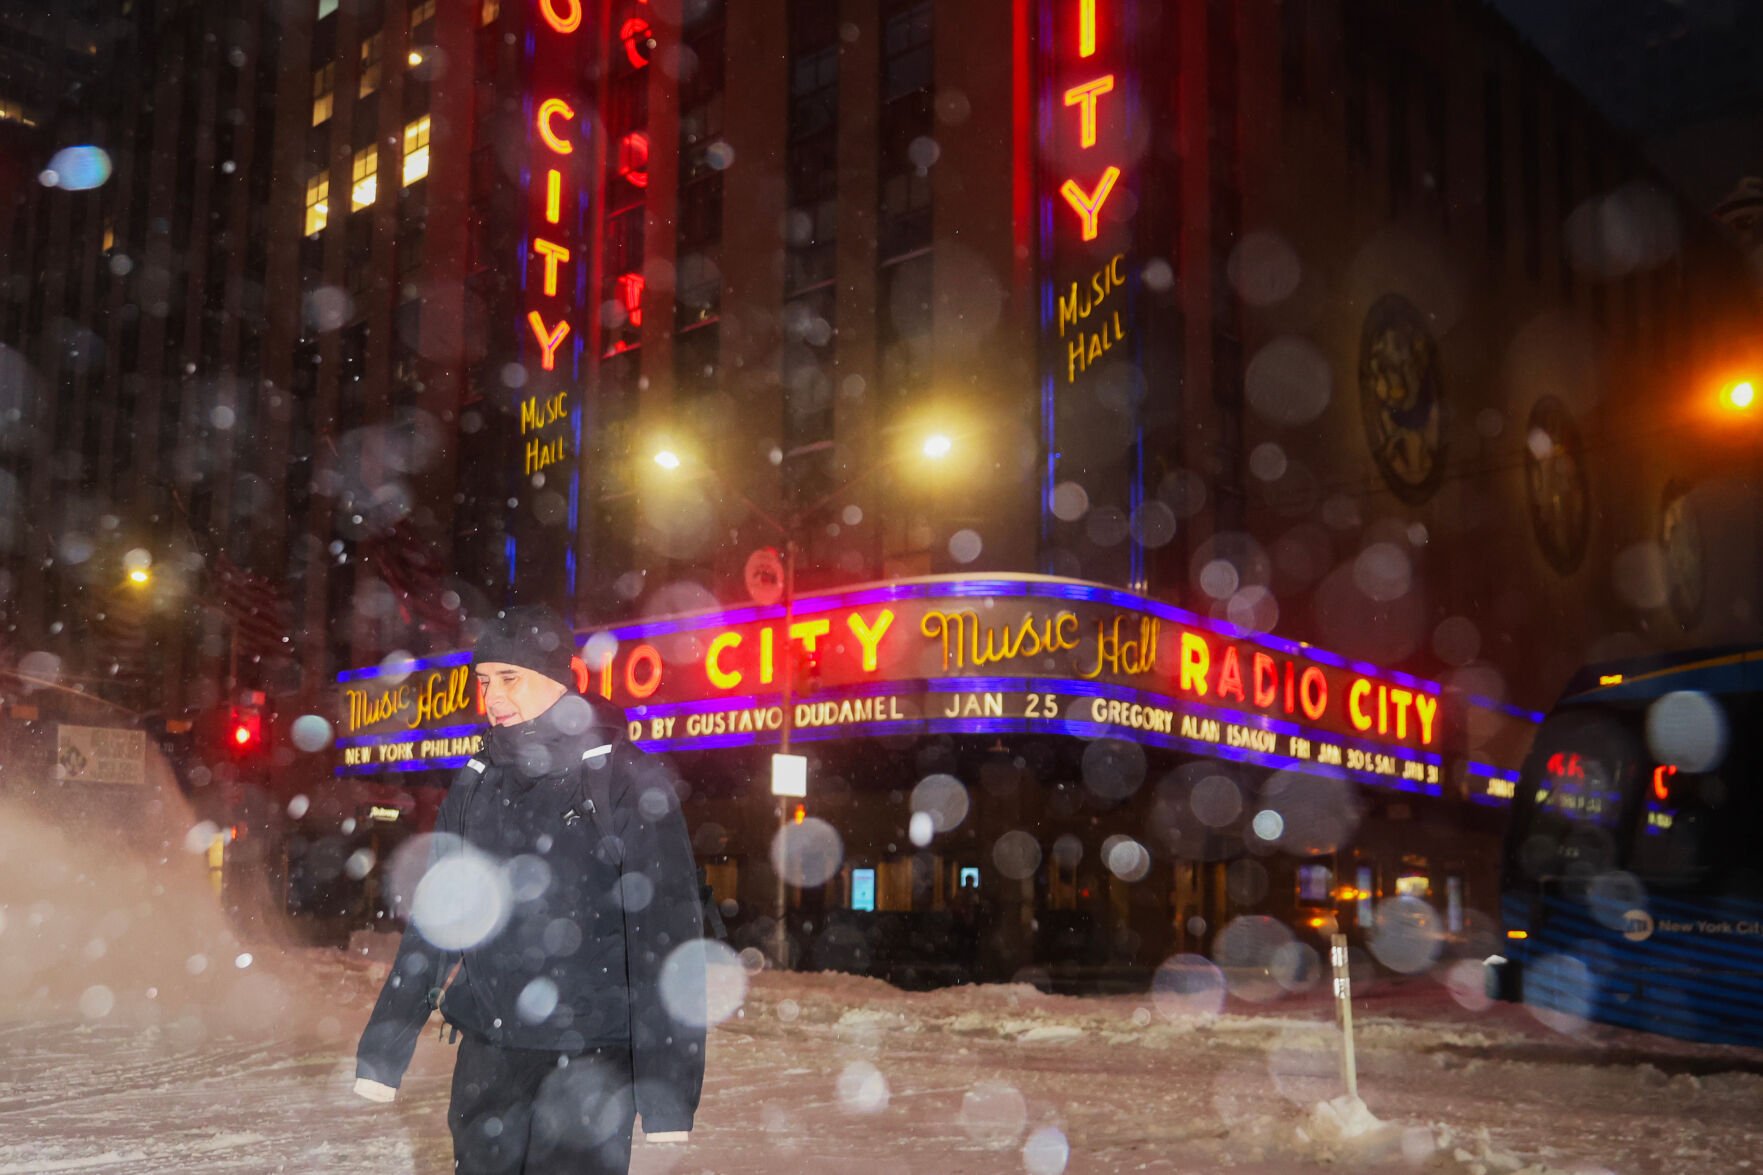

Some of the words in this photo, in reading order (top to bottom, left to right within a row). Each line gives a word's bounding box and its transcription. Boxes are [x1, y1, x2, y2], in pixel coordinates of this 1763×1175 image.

[527, 98, 575, 371] CITY
[705, 608, 895, 690] CITY
[920, 610, 1080, 673] Music
[1072, 614, 1161, 680] Hall
[346, 684, 410, 732] Music
[407, 664, 471, 729] Hall
[651, 717, 676, 740] BY
[686, 706, 783, 736] GUSTAVO
[795, 696, 904, 728] DUDAMEL
[944, 692, 1003, 719] JAN
[1024, 693, 1059, 719] 25
[1180, 631, 1328, 721] RADIO
[1349, 678, 1438, 744] CITY
[345, 746, 372, 766] NEW
[379, 741, 414, 762] YORK
[1091, 698, 1174, 734] GREGORY
[1181, 715, 1220, 743] ALAN
[1226, 724, 1276, 753] ISAKOV
[1659, 920, 1693, 933] New
[1697, 920, 1731, 934] York
